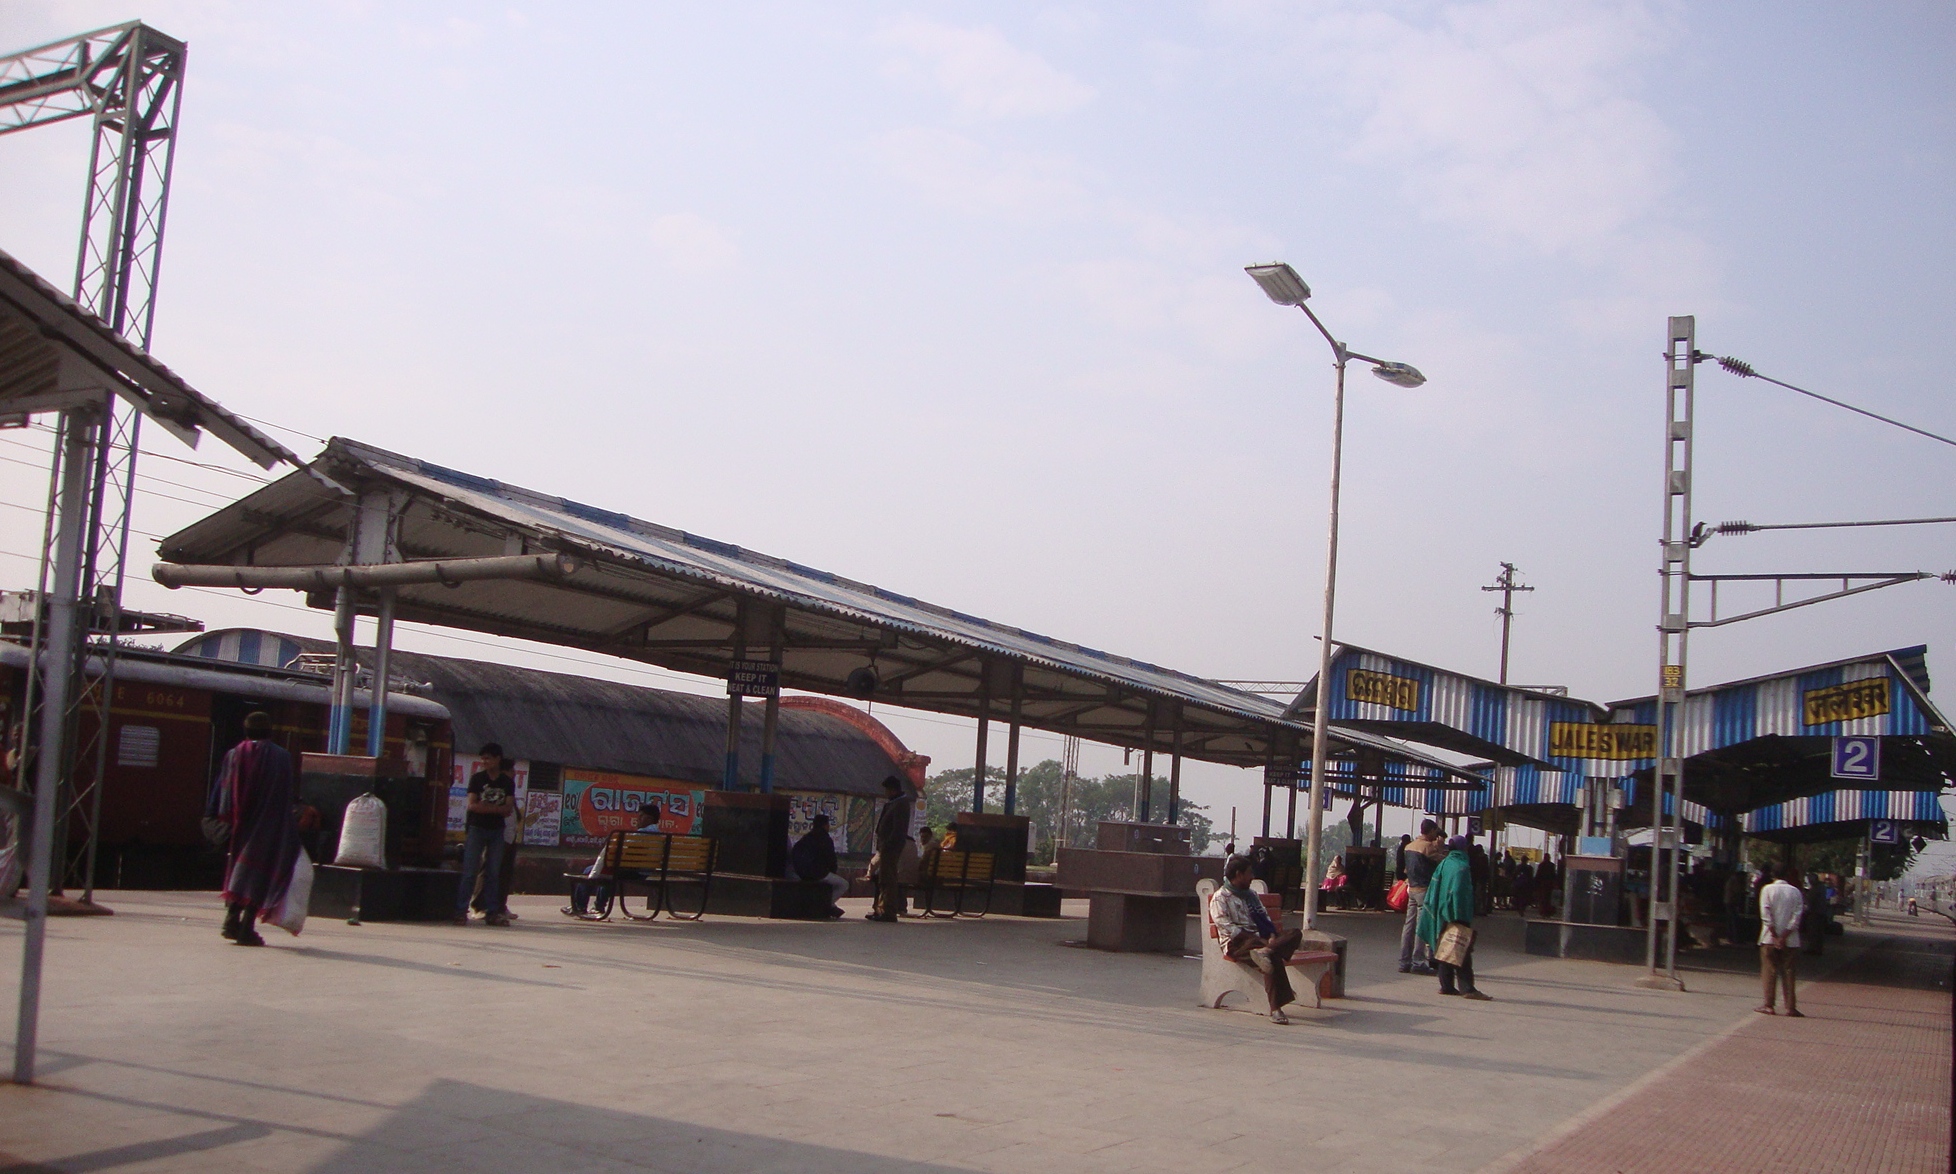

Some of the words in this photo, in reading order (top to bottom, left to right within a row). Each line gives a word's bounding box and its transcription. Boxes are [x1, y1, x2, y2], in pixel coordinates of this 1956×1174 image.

[735, 672, 757, 683] KEEP
[758, 674, 767, 683] IT
[727, 683, 745, 693] NEAT
[746, 684, 751, 694] &
[753, 685, 776, 696] CLEAN
[146, 691, 185, 707] 6064
[1808, 683, 1887, 718] जलेश्वर
[1551, 728, 1655, 753] JALESWAR
[1843, 741, 1868, 773] 2
[1470, 819, 1481, 833] 3
[1875, 821, 1891, 840] 2
